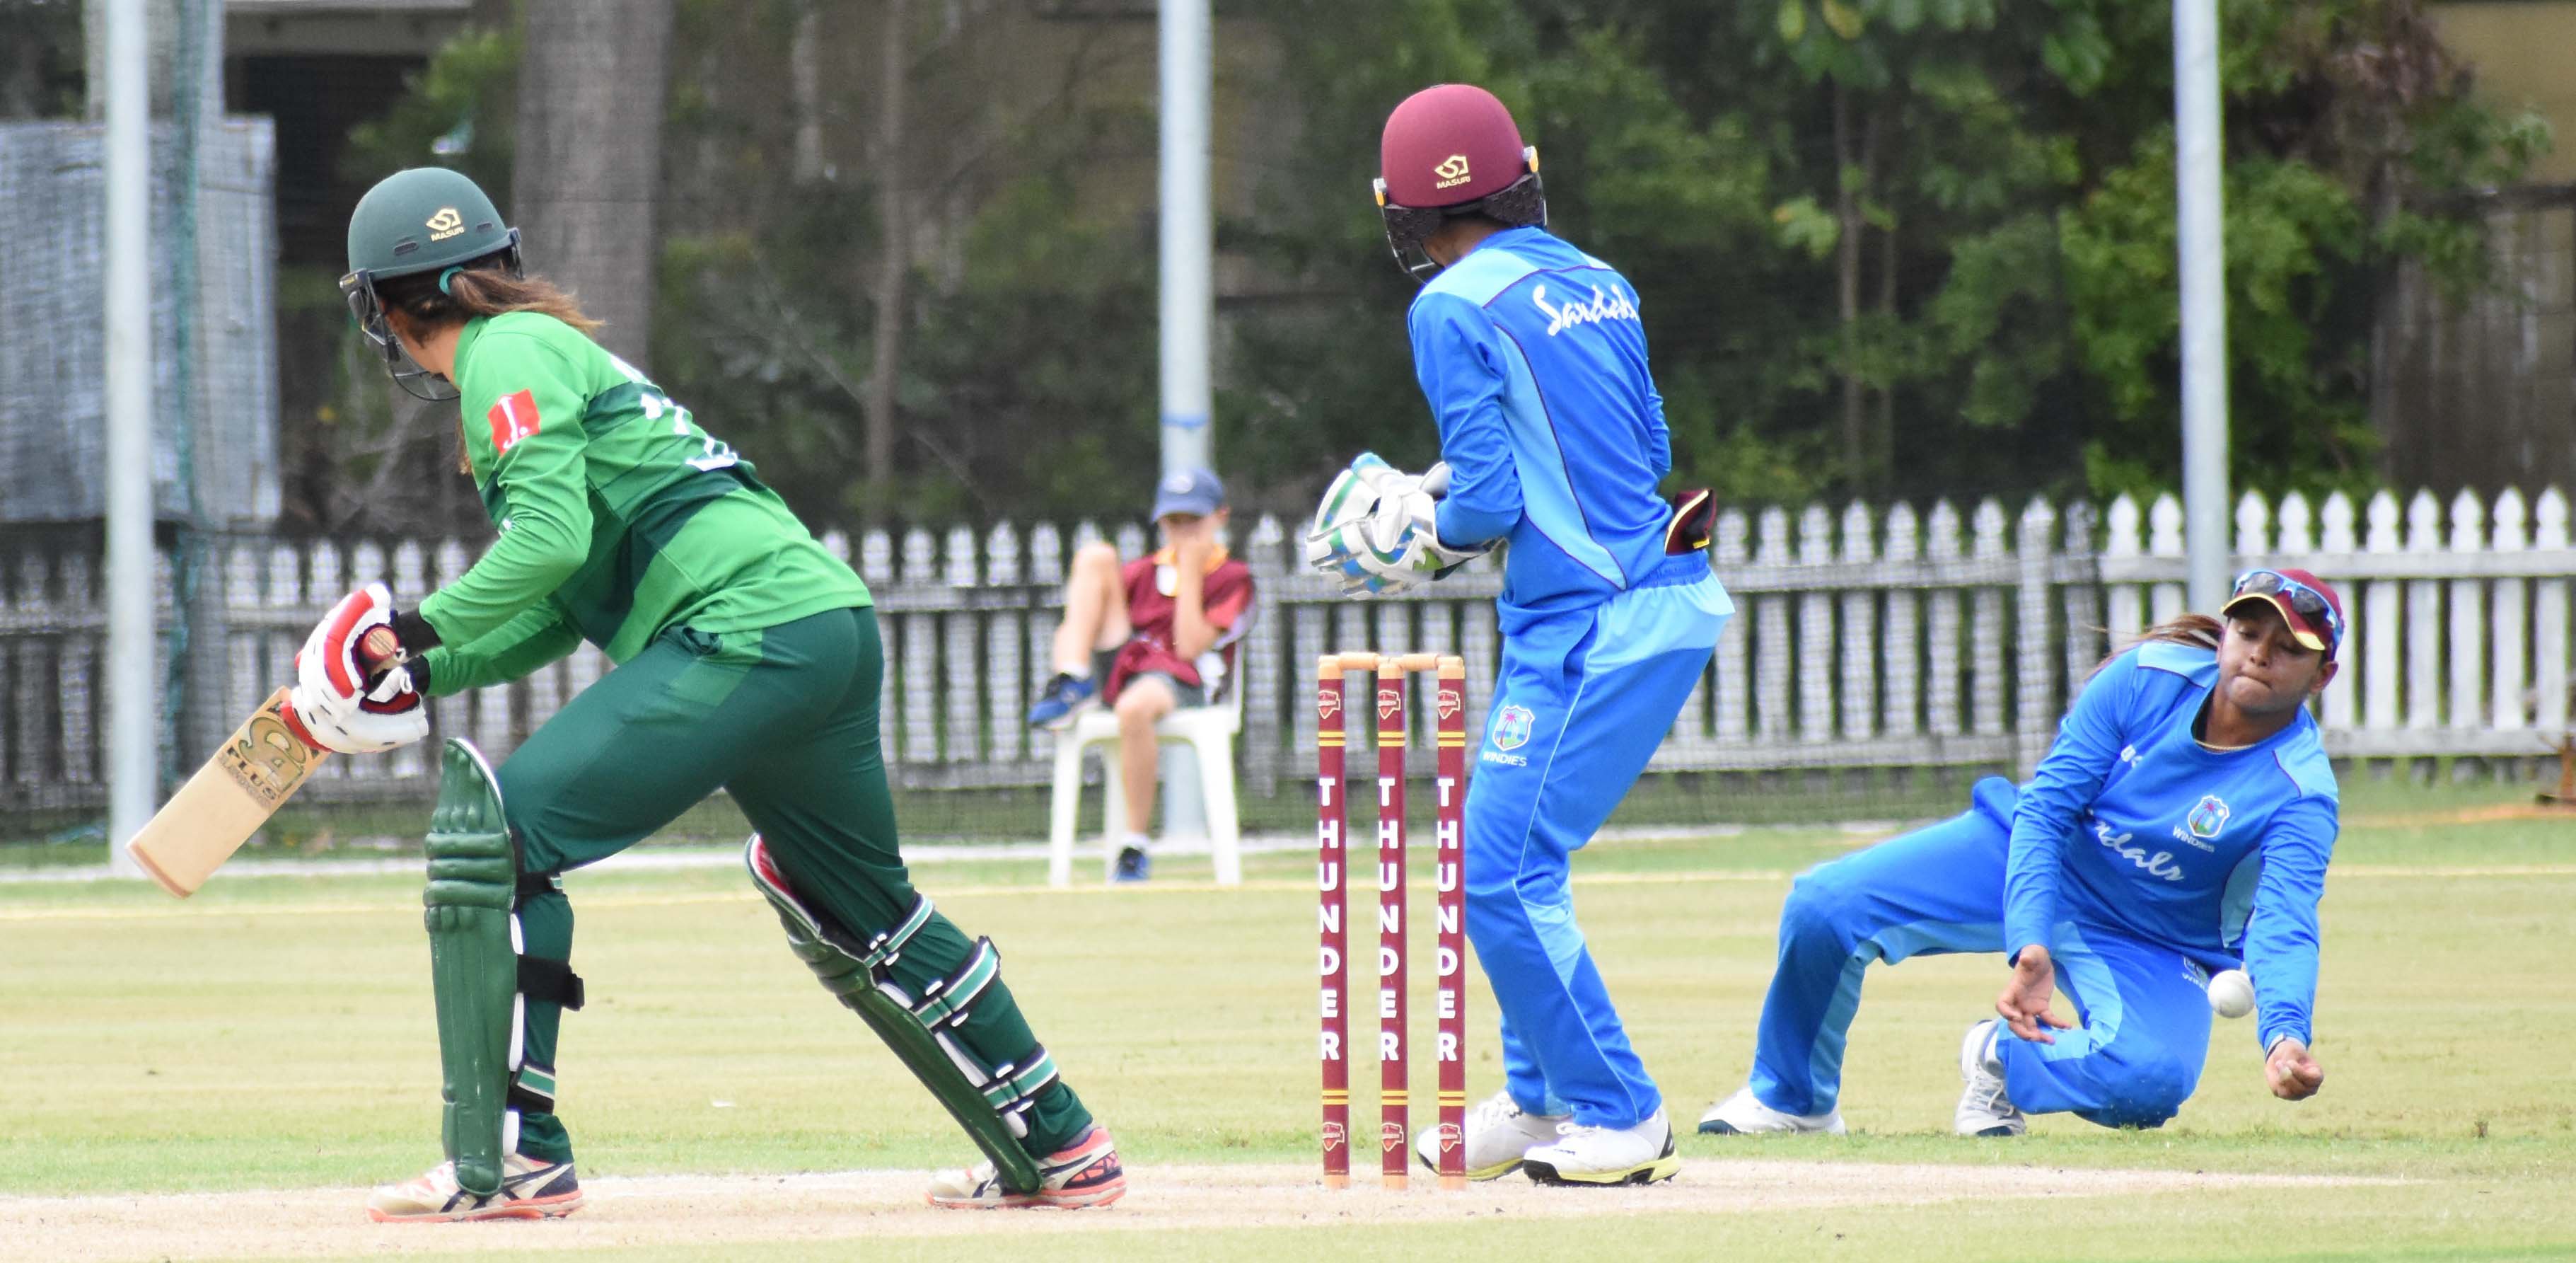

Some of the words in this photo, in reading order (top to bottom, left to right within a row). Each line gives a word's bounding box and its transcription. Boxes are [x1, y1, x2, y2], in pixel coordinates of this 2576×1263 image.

[430, 226, 465, 242] MASURI
[1437, 175, 1471, 190] MASURI
[1482, 751, 1528, 767] WINDIES
[1318, 778, 1340, 1061] THUNDER
[1379, 778, 1400, 1061] THUNDER
[1437, 778, 1458, 1062] THUNDER
